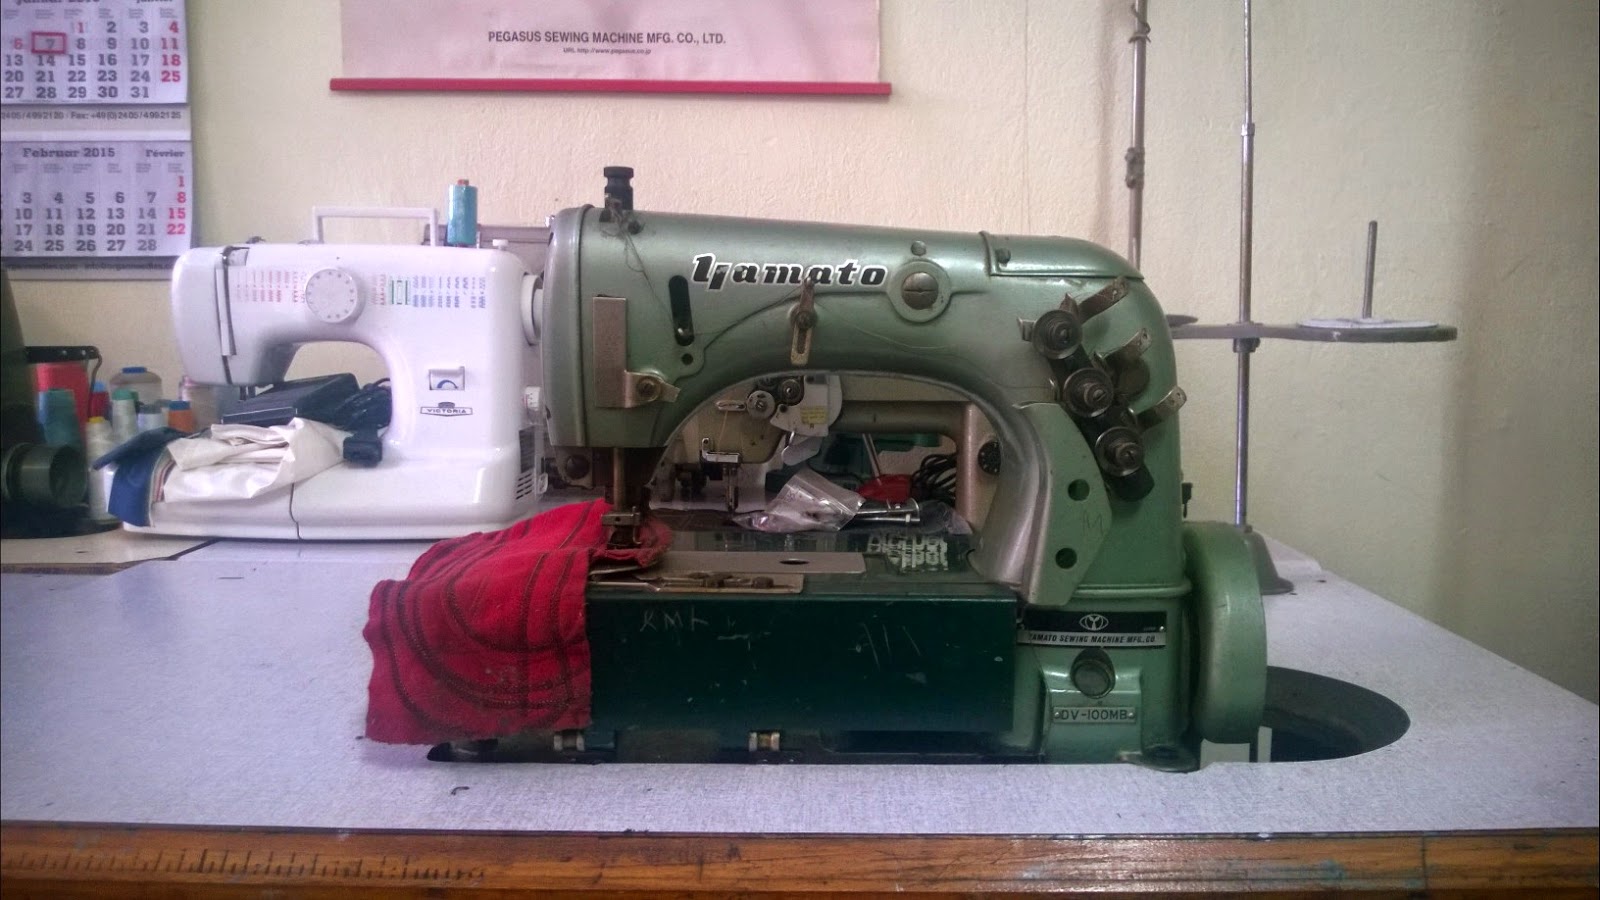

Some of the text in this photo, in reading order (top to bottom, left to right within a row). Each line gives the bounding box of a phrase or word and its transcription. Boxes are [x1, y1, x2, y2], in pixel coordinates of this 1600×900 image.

[78, 21, 179, 33] 1 2 3 4
[75, 38, 85, 50] 8
[106, 37, 117, 49] 9
[131, 38, 149, 50] 10
[161, 38, 178, 50] 11
[488, 31, 726, 44] PEGASUS SEWING MACHINE MFG. CO., LTD.
[6, 54, 181, 66] 13 14 15 16 17 18
[5, 70, 180, 82] 20 21 22 23 24 25
[5, 86, 149, 98] 27 28 29 30 31
[23, 148, 185, 157] Februar 2015 Février
[178, 176, 184, 187] 1
[23, 192, 186, 204] 3 4 5 6 7 8
[16, 207, 185, 220] 10 11 12 13 14 15
[16, 223, 185, 236] 17 18 19 20 21 22
[14, 239, 157, 252] 24 25 26 27 28
[693, 253, 889, 291] Yamato
[1059, 635, 1088, 643] SEWING
[1091, 635, 1124, 644] MACHINE
